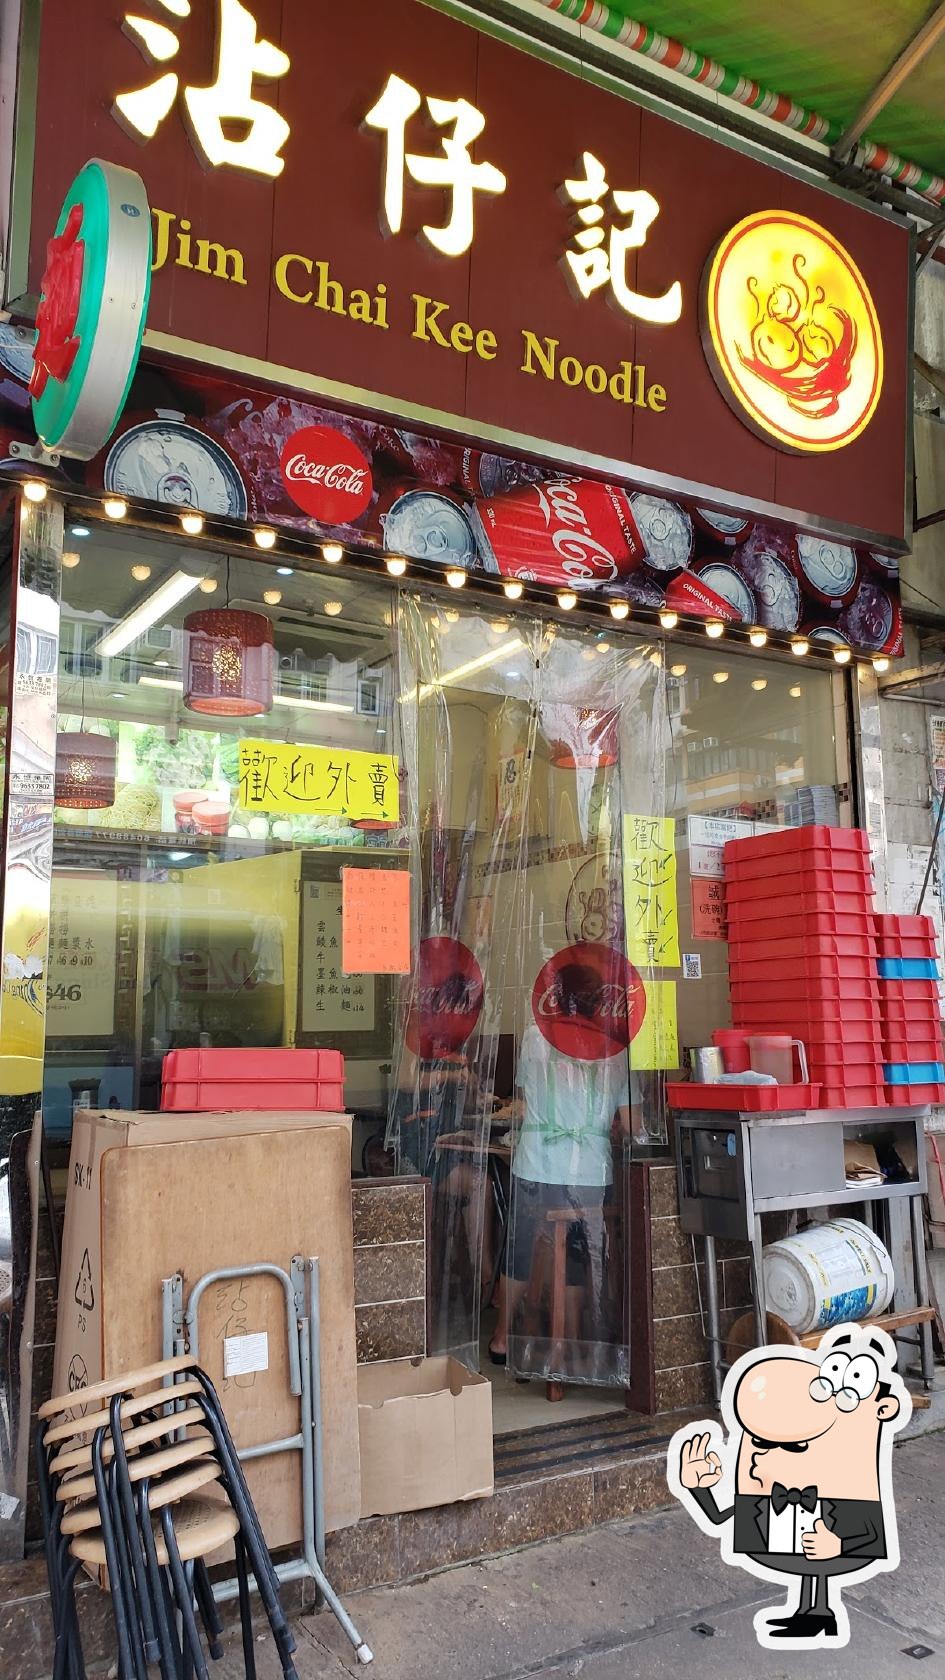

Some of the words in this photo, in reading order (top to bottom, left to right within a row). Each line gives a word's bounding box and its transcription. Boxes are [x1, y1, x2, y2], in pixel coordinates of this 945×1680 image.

[150, 208, 247, 285] Jim
[274, 253, 390, 329] Chai
[412, 295, 498, 360] Kee
[520, 329, 668, 412] Noodle
[285, 454, 369, 494] Coca-Cola
[683, 583, 714, 609] ORIGINAL
[238, 747, 389, 807] 歡迎外賣
[631, 817, 672, 964] 歡迎外賣
